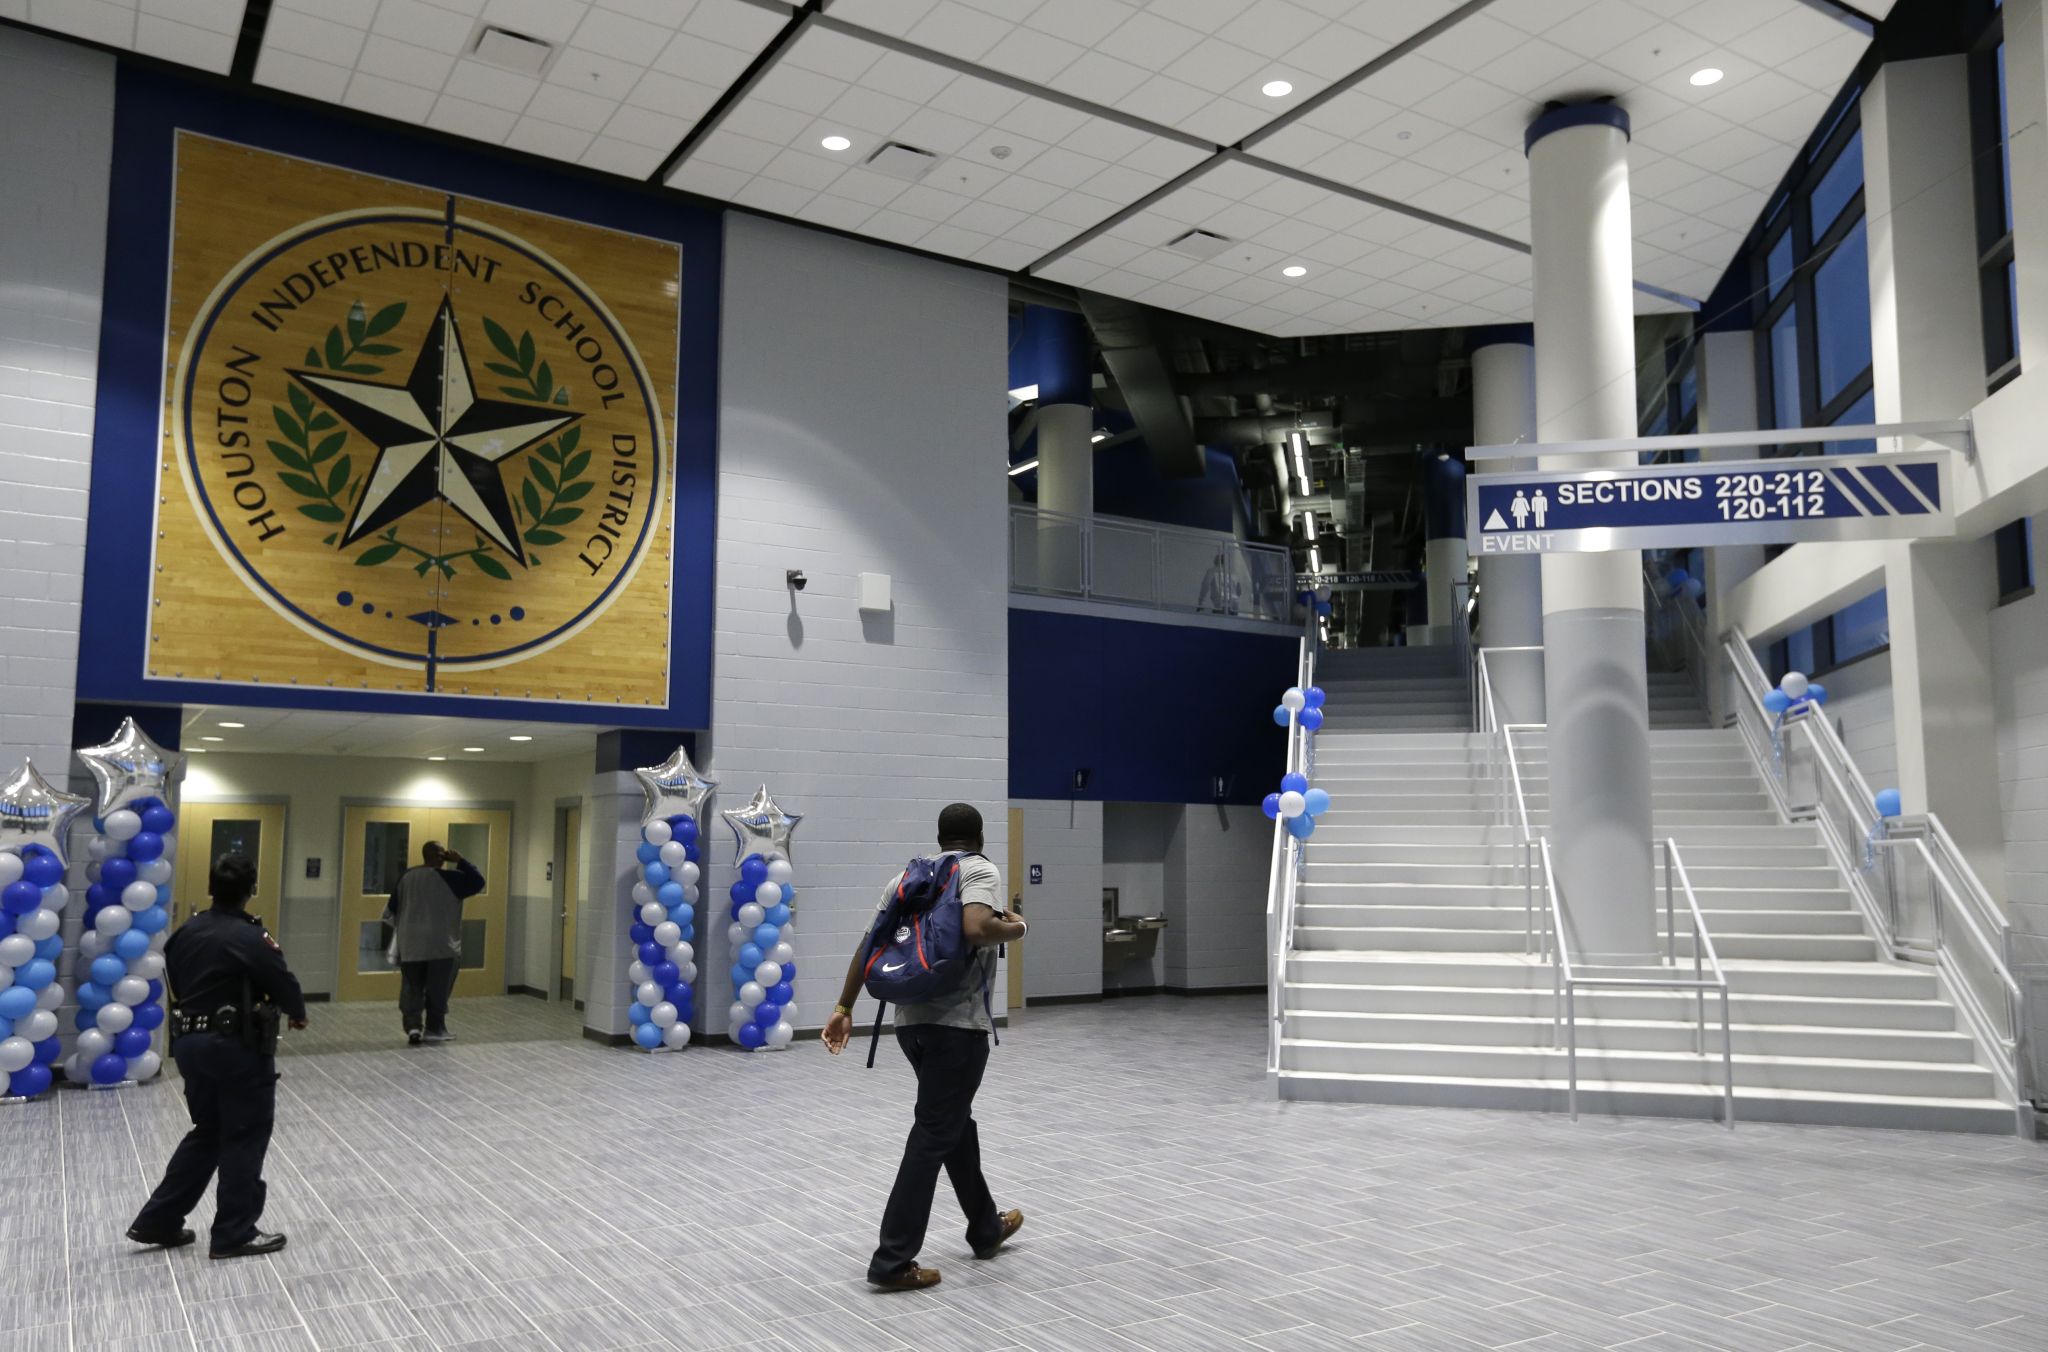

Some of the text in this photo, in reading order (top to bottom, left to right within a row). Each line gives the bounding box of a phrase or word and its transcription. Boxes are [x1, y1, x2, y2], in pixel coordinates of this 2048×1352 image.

[217, 241, 637, 576] HOUSTON INDEPENDENT SCHOOL DISTRICT
[1558, 471, 1825, 505] SECTIONS 220-212
[1718, 494, 1825, 520] 120-112
[1482, 533, 1555, 552] EVENT
